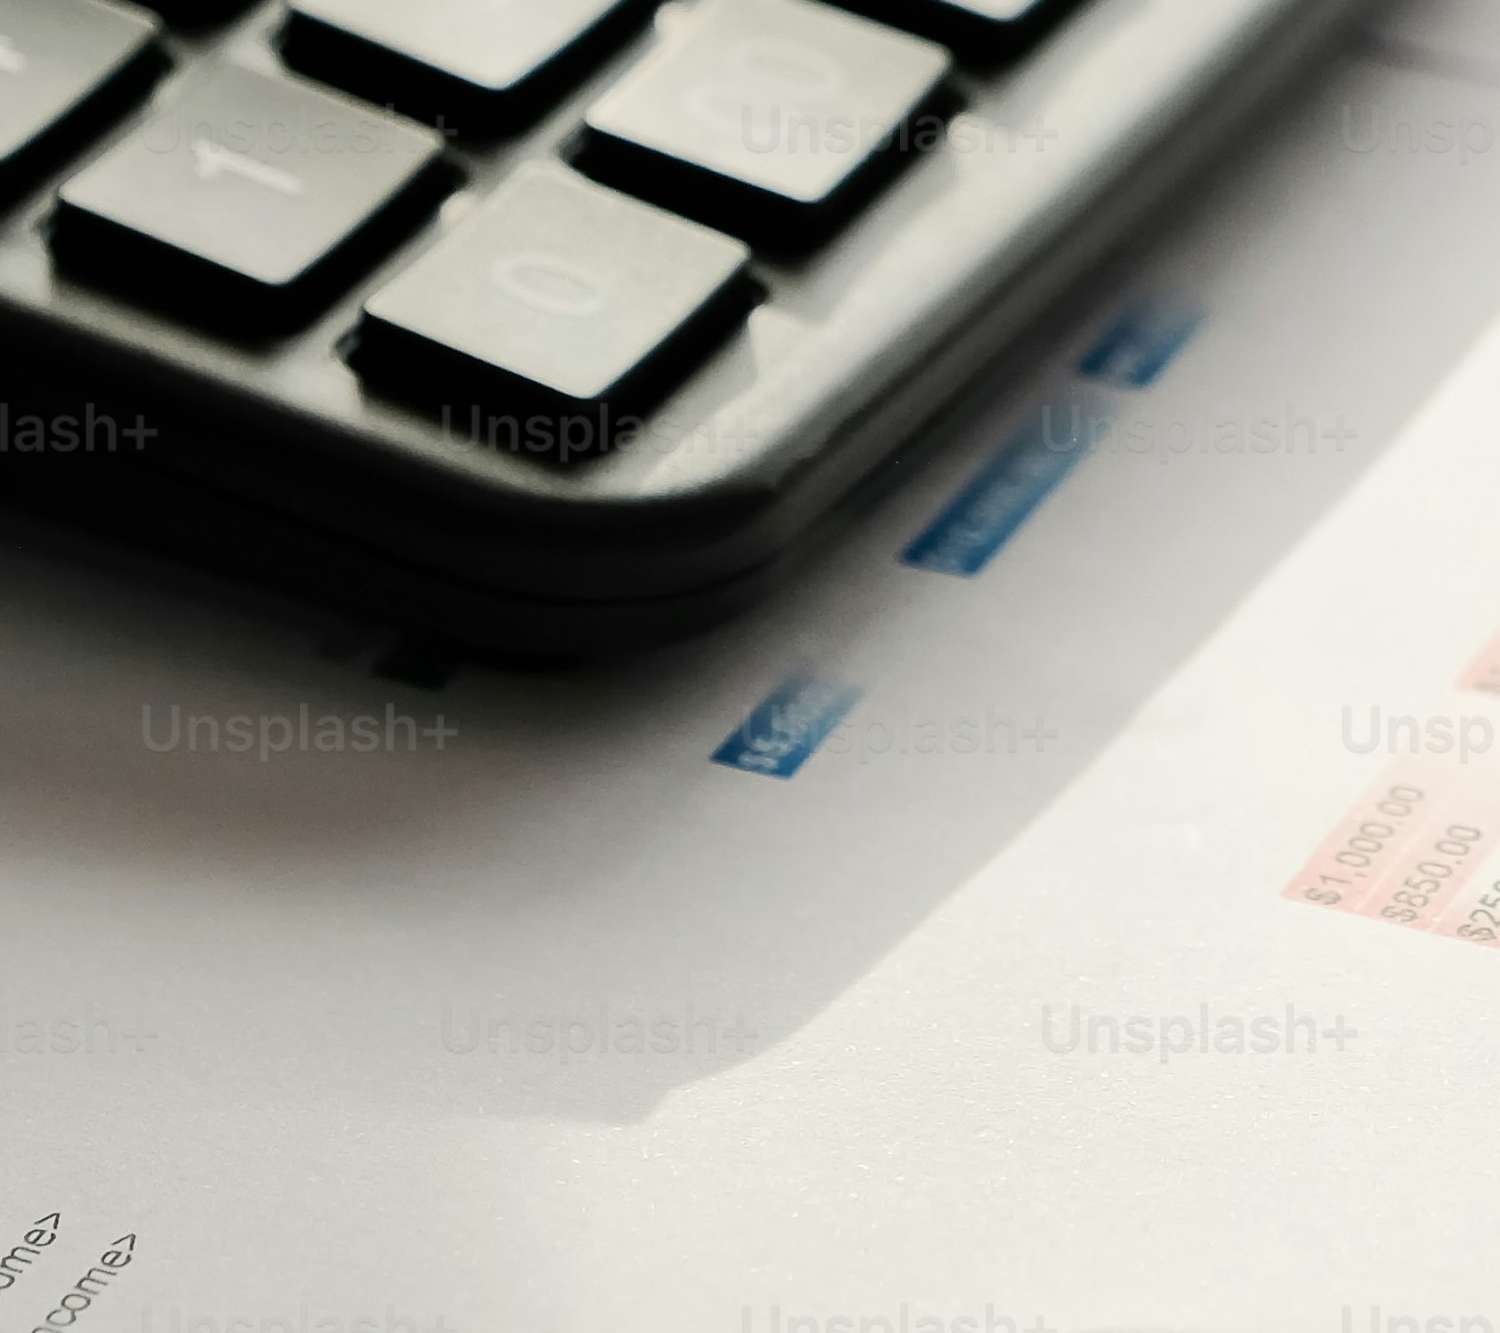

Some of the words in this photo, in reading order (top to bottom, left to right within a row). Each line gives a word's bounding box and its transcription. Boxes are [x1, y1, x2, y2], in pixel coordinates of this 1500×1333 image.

[192, 137, 304, 197] 1
[492, 250, 600, 316] 0
[1303, 784, 1426, 908] $1,000.00
[1380, 823, 1484, 924] $850.00
